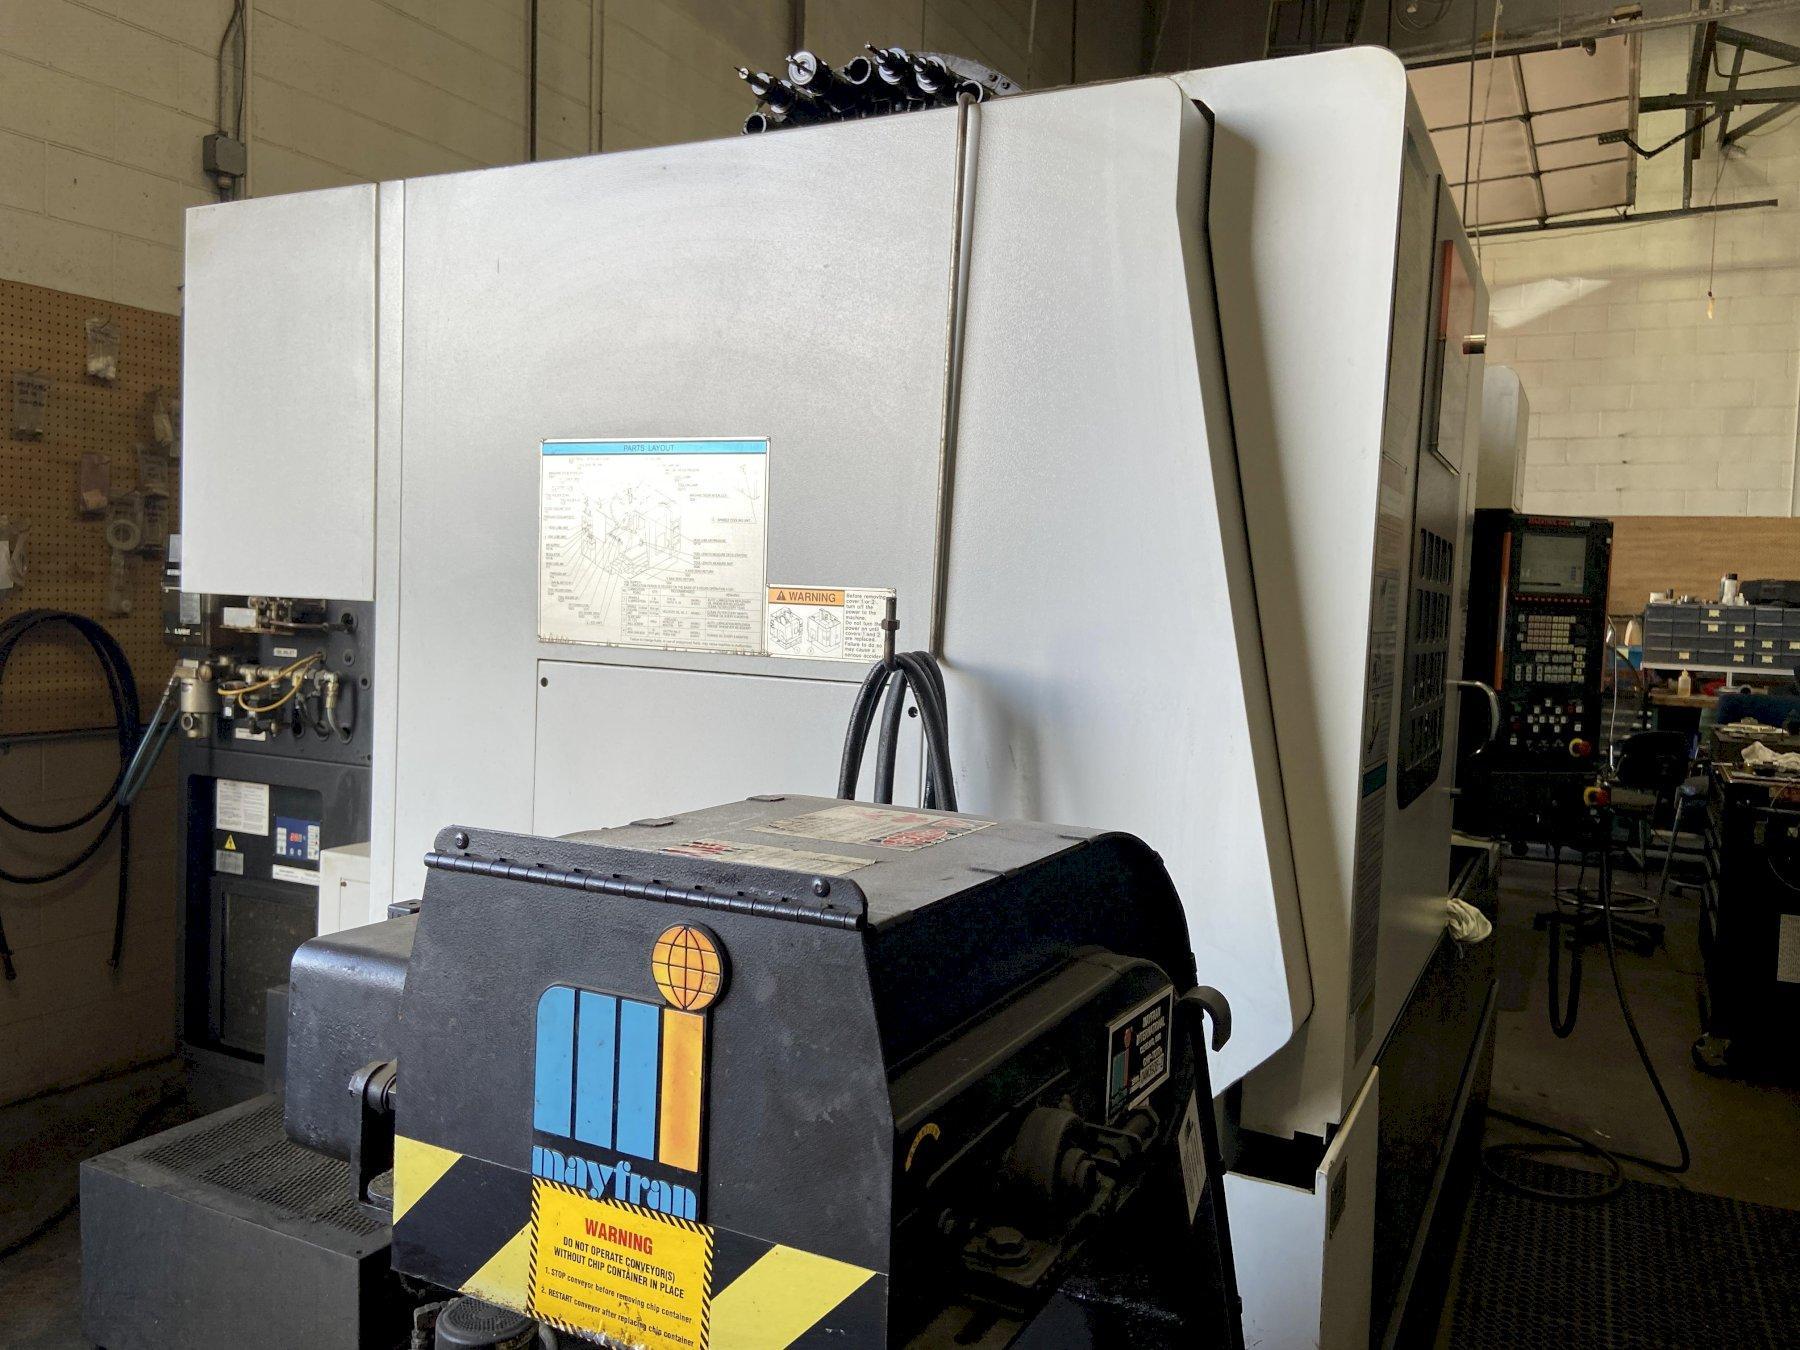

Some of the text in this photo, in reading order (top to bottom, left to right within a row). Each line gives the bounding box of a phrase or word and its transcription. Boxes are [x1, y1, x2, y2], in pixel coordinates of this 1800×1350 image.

[789, 592, 836, 602] WARNING
[532, 1145, 697, 1221] mayfran
[563, 1237, 675, 1283] DO NOT OPERATE CONVEYOR(S)
[585, 1218, 653, 1255] WARNING
[551, 1269, 566, 1279] STOP
[567, 1276, 594, 1289] conveyor
[596, 1284, 614, 1296] before
[616, 1292, 644, 1308] removing
[646, 1303, 660, 1313] chip
[662, 1308, 692, 1323] container
[554, 1247, 684, 1298] WITHOUT CHIP CONTAINER IN PLACE
[549, 1289, 573, 1303] RESTART
[574, 1299, 601, 1313] conveyor
[602, 1308, 616, 1318] after
[618, 1315, 647, 1331] replacing
[648, 1325, 662, 1336] chip
[664, 1331, 694, 1346] container
